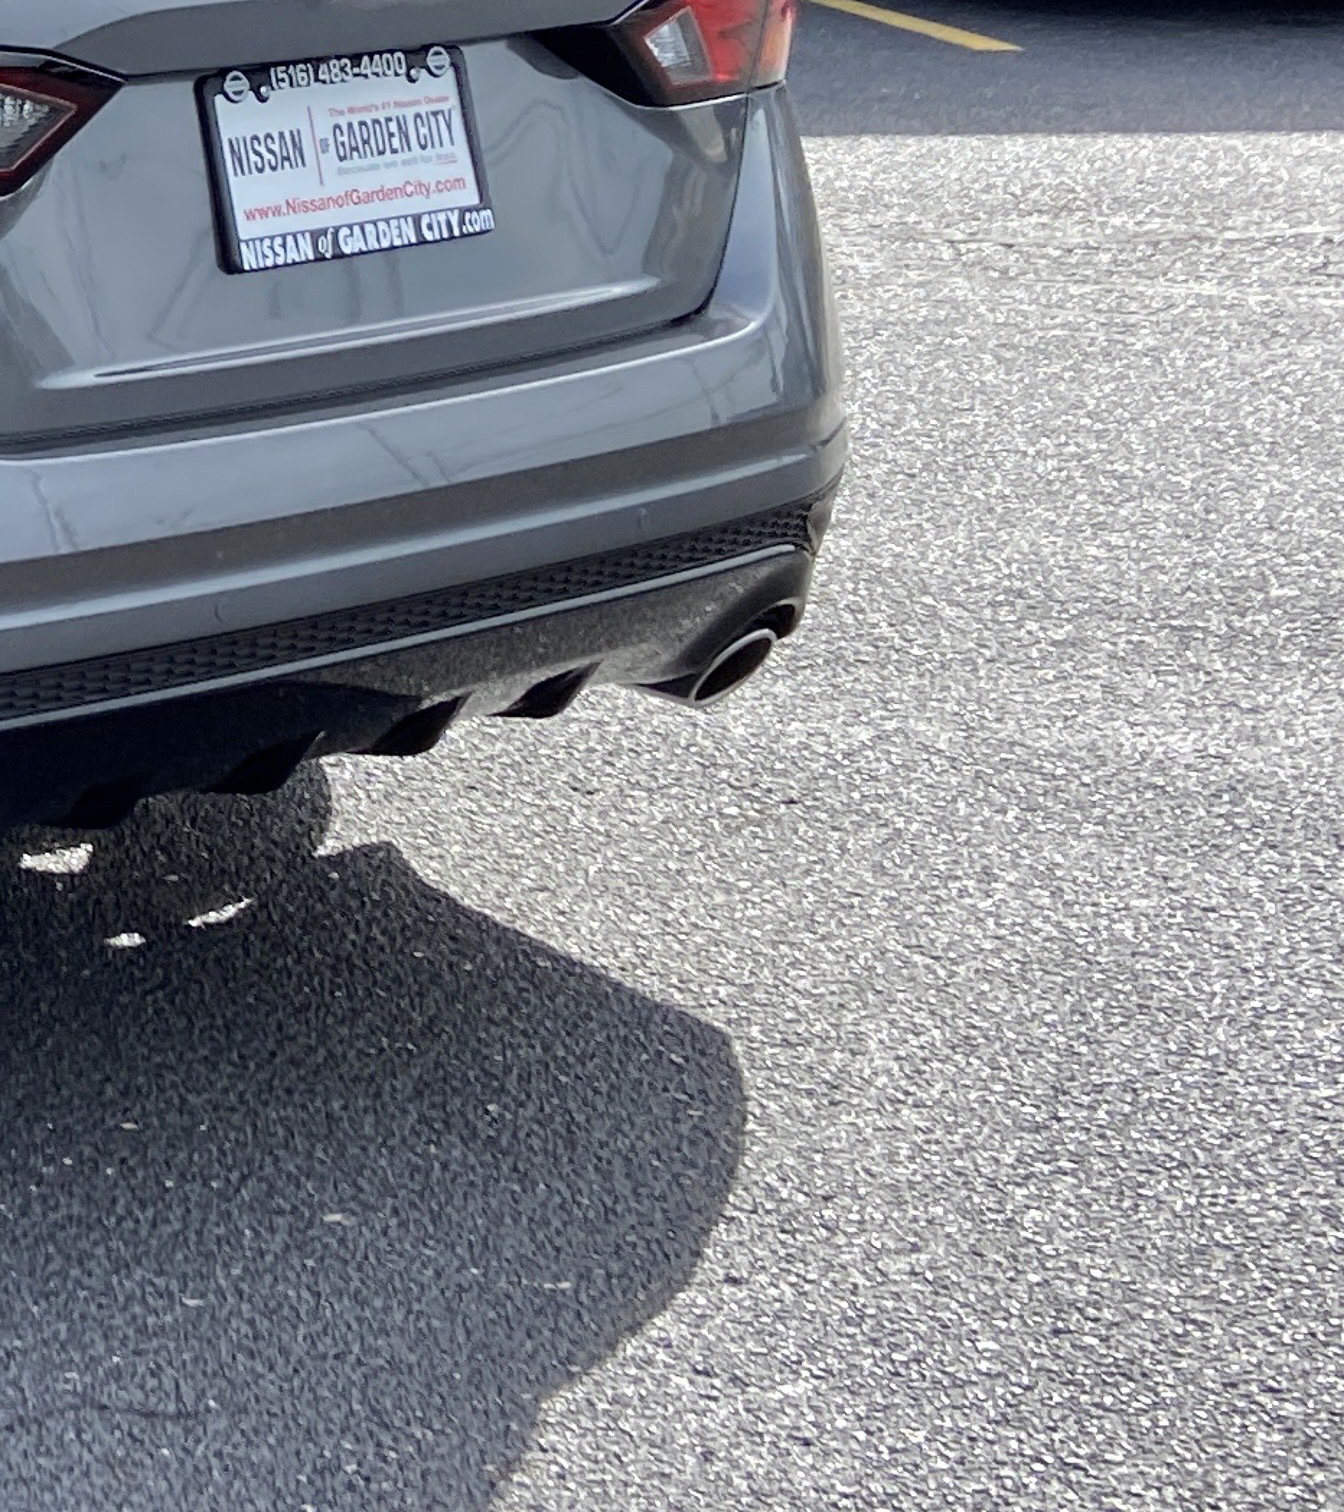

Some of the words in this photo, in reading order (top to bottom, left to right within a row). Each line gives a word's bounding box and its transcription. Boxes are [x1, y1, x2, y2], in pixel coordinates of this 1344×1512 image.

[270, 63, 313, 89] (516)
[318, 51, 406, 83] 483-4400
[226, 127, 307, 178] NISSAN
[332, 114, 412, 163] GARDEN
[413, 108, 456, 152] CITY
[243, 176, 467, 222] www.NissanofGardenCity.com
[240, 231, 314, 272] NISSAN
[318, 226, 336, 260] of
[338, 216, 416, 255] GARDEN
